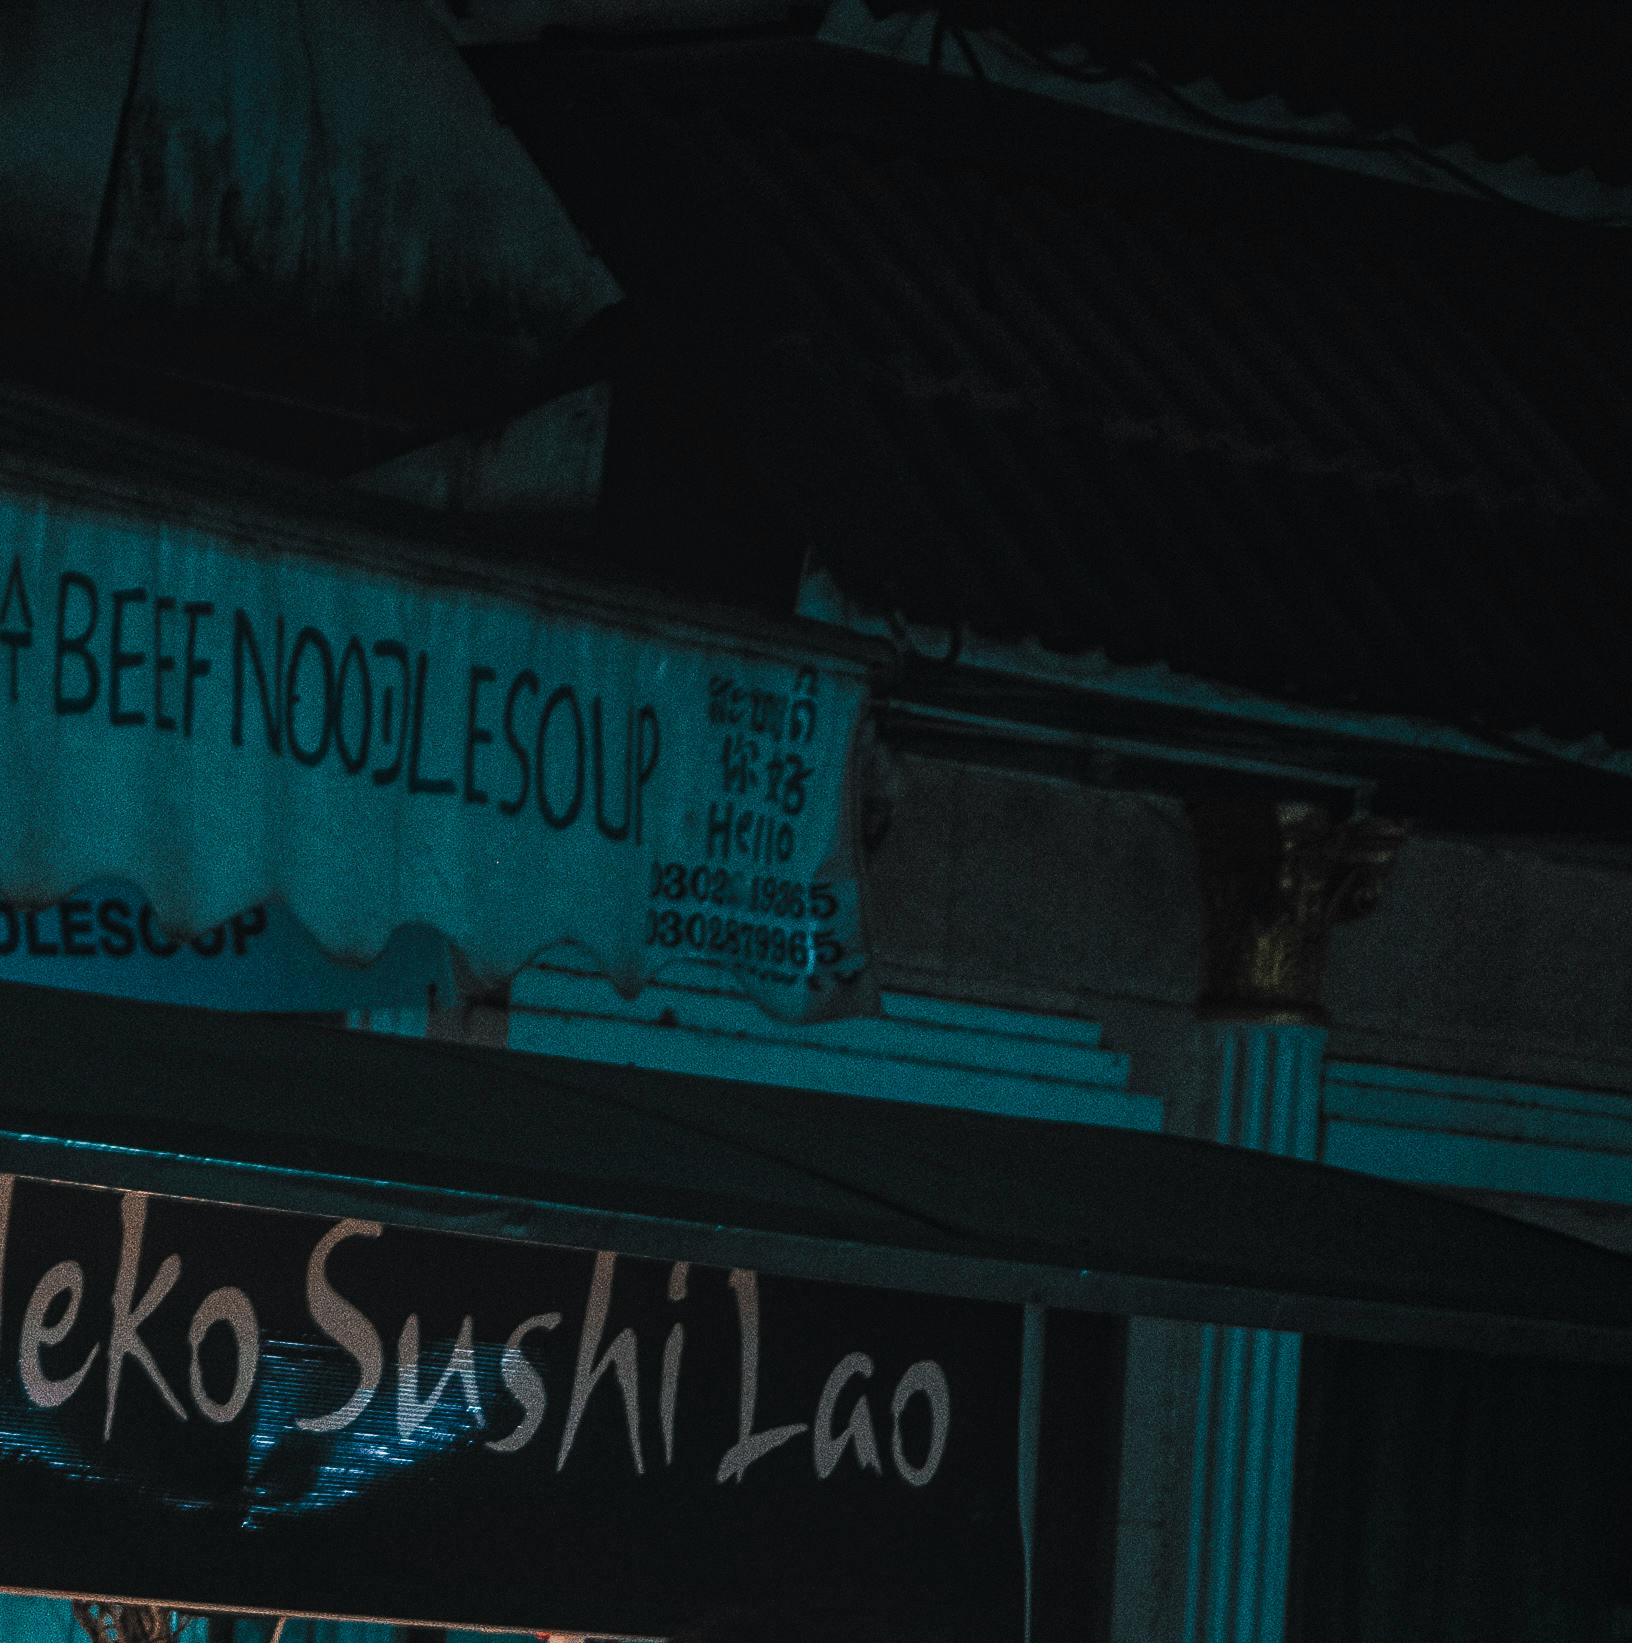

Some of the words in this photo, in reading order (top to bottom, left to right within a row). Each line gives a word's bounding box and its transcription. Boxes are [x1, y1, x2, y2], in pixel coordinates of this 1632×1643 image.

[52, 571, 214, 738] BEEF
[707, 801, 794, 865] Hello
[295, 1217, 691, 1476] Sushi
[717, 1266, 951, 1488] Lao
